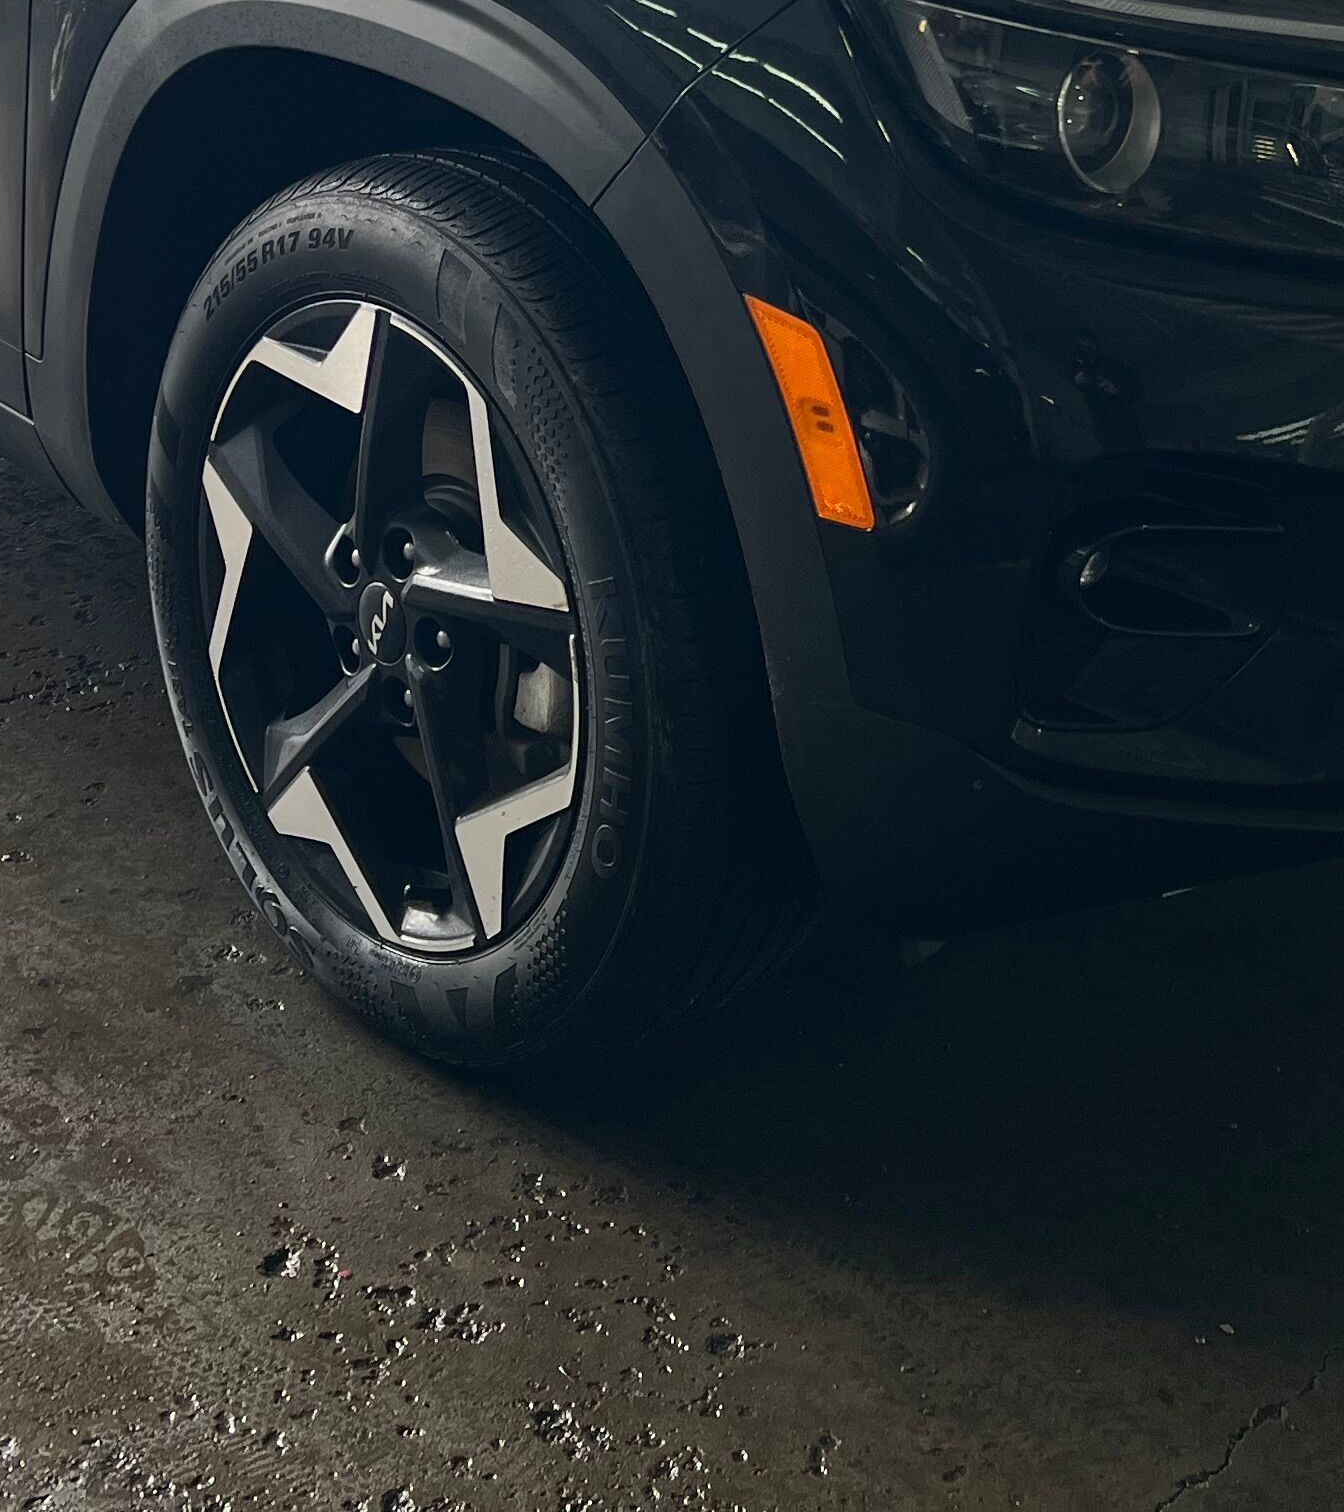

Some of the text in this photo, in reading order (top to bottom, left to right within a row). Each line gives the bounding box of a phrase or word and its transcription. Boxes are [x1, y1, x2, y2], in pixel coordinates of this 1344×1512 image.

[204, 248, 258, 320] 215/55
[261, 231, 301, 264] R17
[308, 227, 355, 250] 94V
[367, 590, 394, 656] KIA
[587, 576, 633, 879] KUMHO
